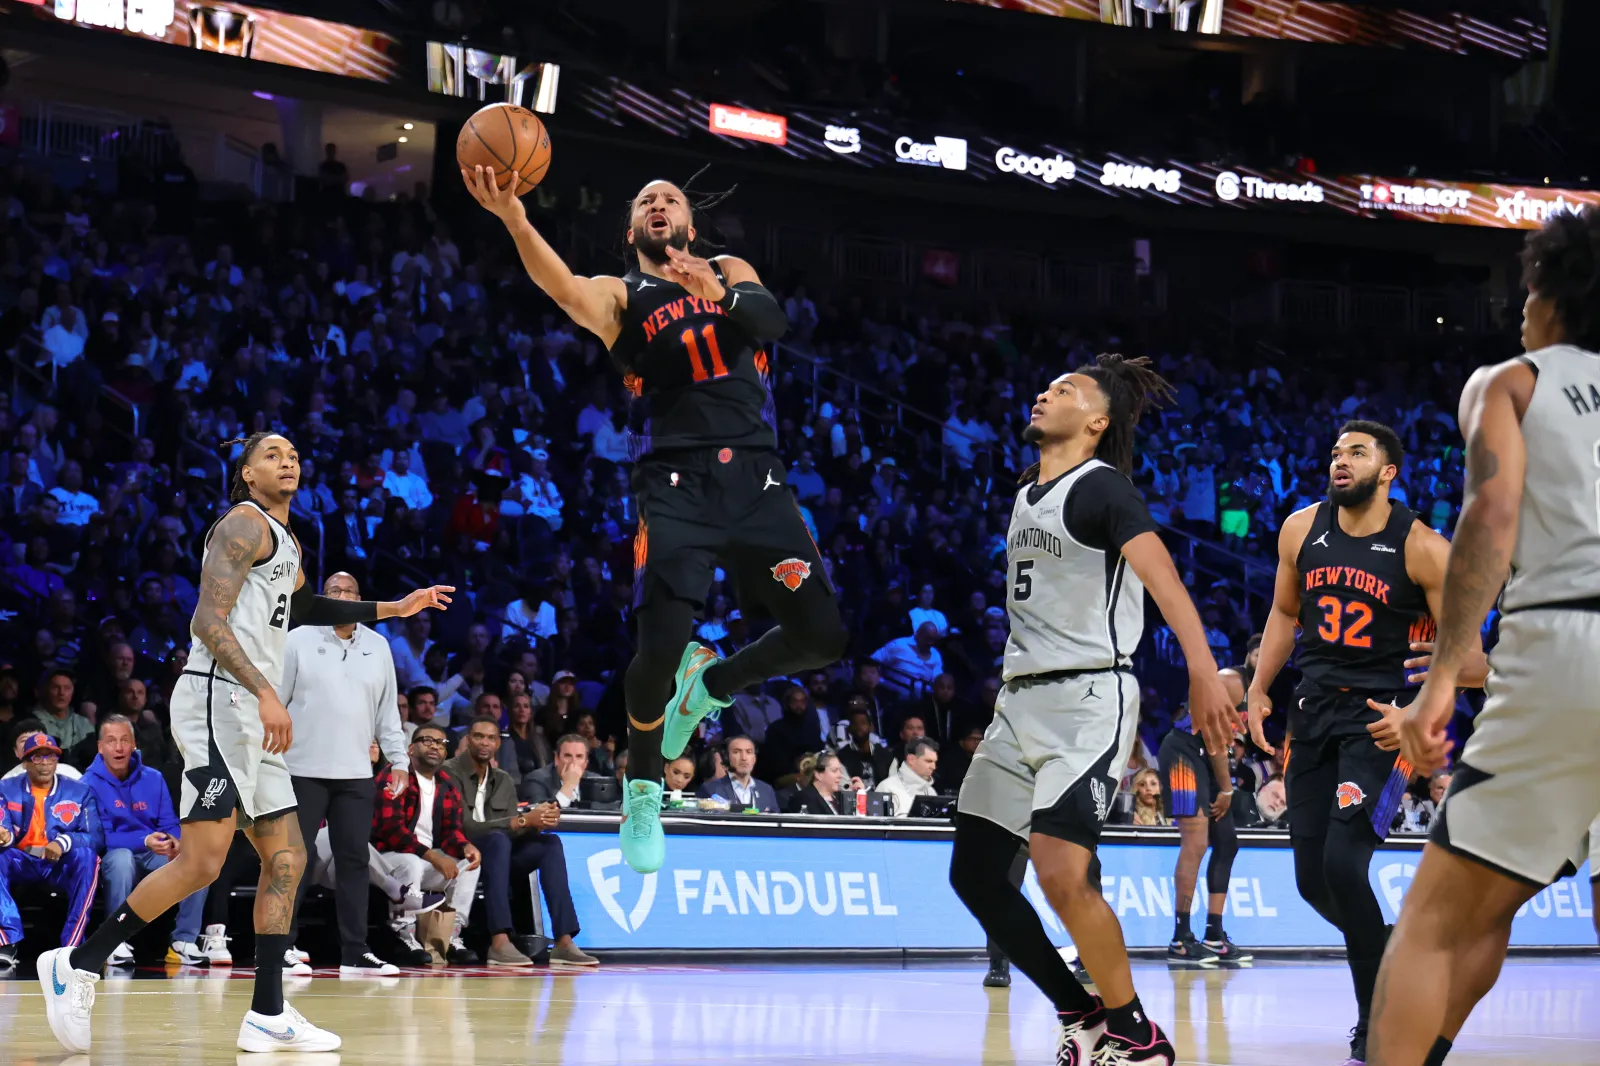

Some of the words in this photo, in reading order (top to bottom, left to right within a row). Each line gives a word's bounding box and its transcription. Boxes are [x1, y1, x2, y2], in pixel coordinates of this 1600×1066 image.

[824, 125, 861, 145] aws
[995, 147, 1076, 183] Google
[1242, 177, 1324, 203] Threads
[1391, 185, 1472, 208] TISSOT
[642, 298, 685, 342] NEW
[681, 323, 730, 383] 11
[1015, 527, 1062, 559] ANTONIO
[1013, 559, 1034, 601] 5
[1306, 566, 1343, 591] NEW
[1344, 567, 1390, 605] YORK
[1318, 595, 1373, 648] 32
[673, 870, 898, 916] FANDUEL
